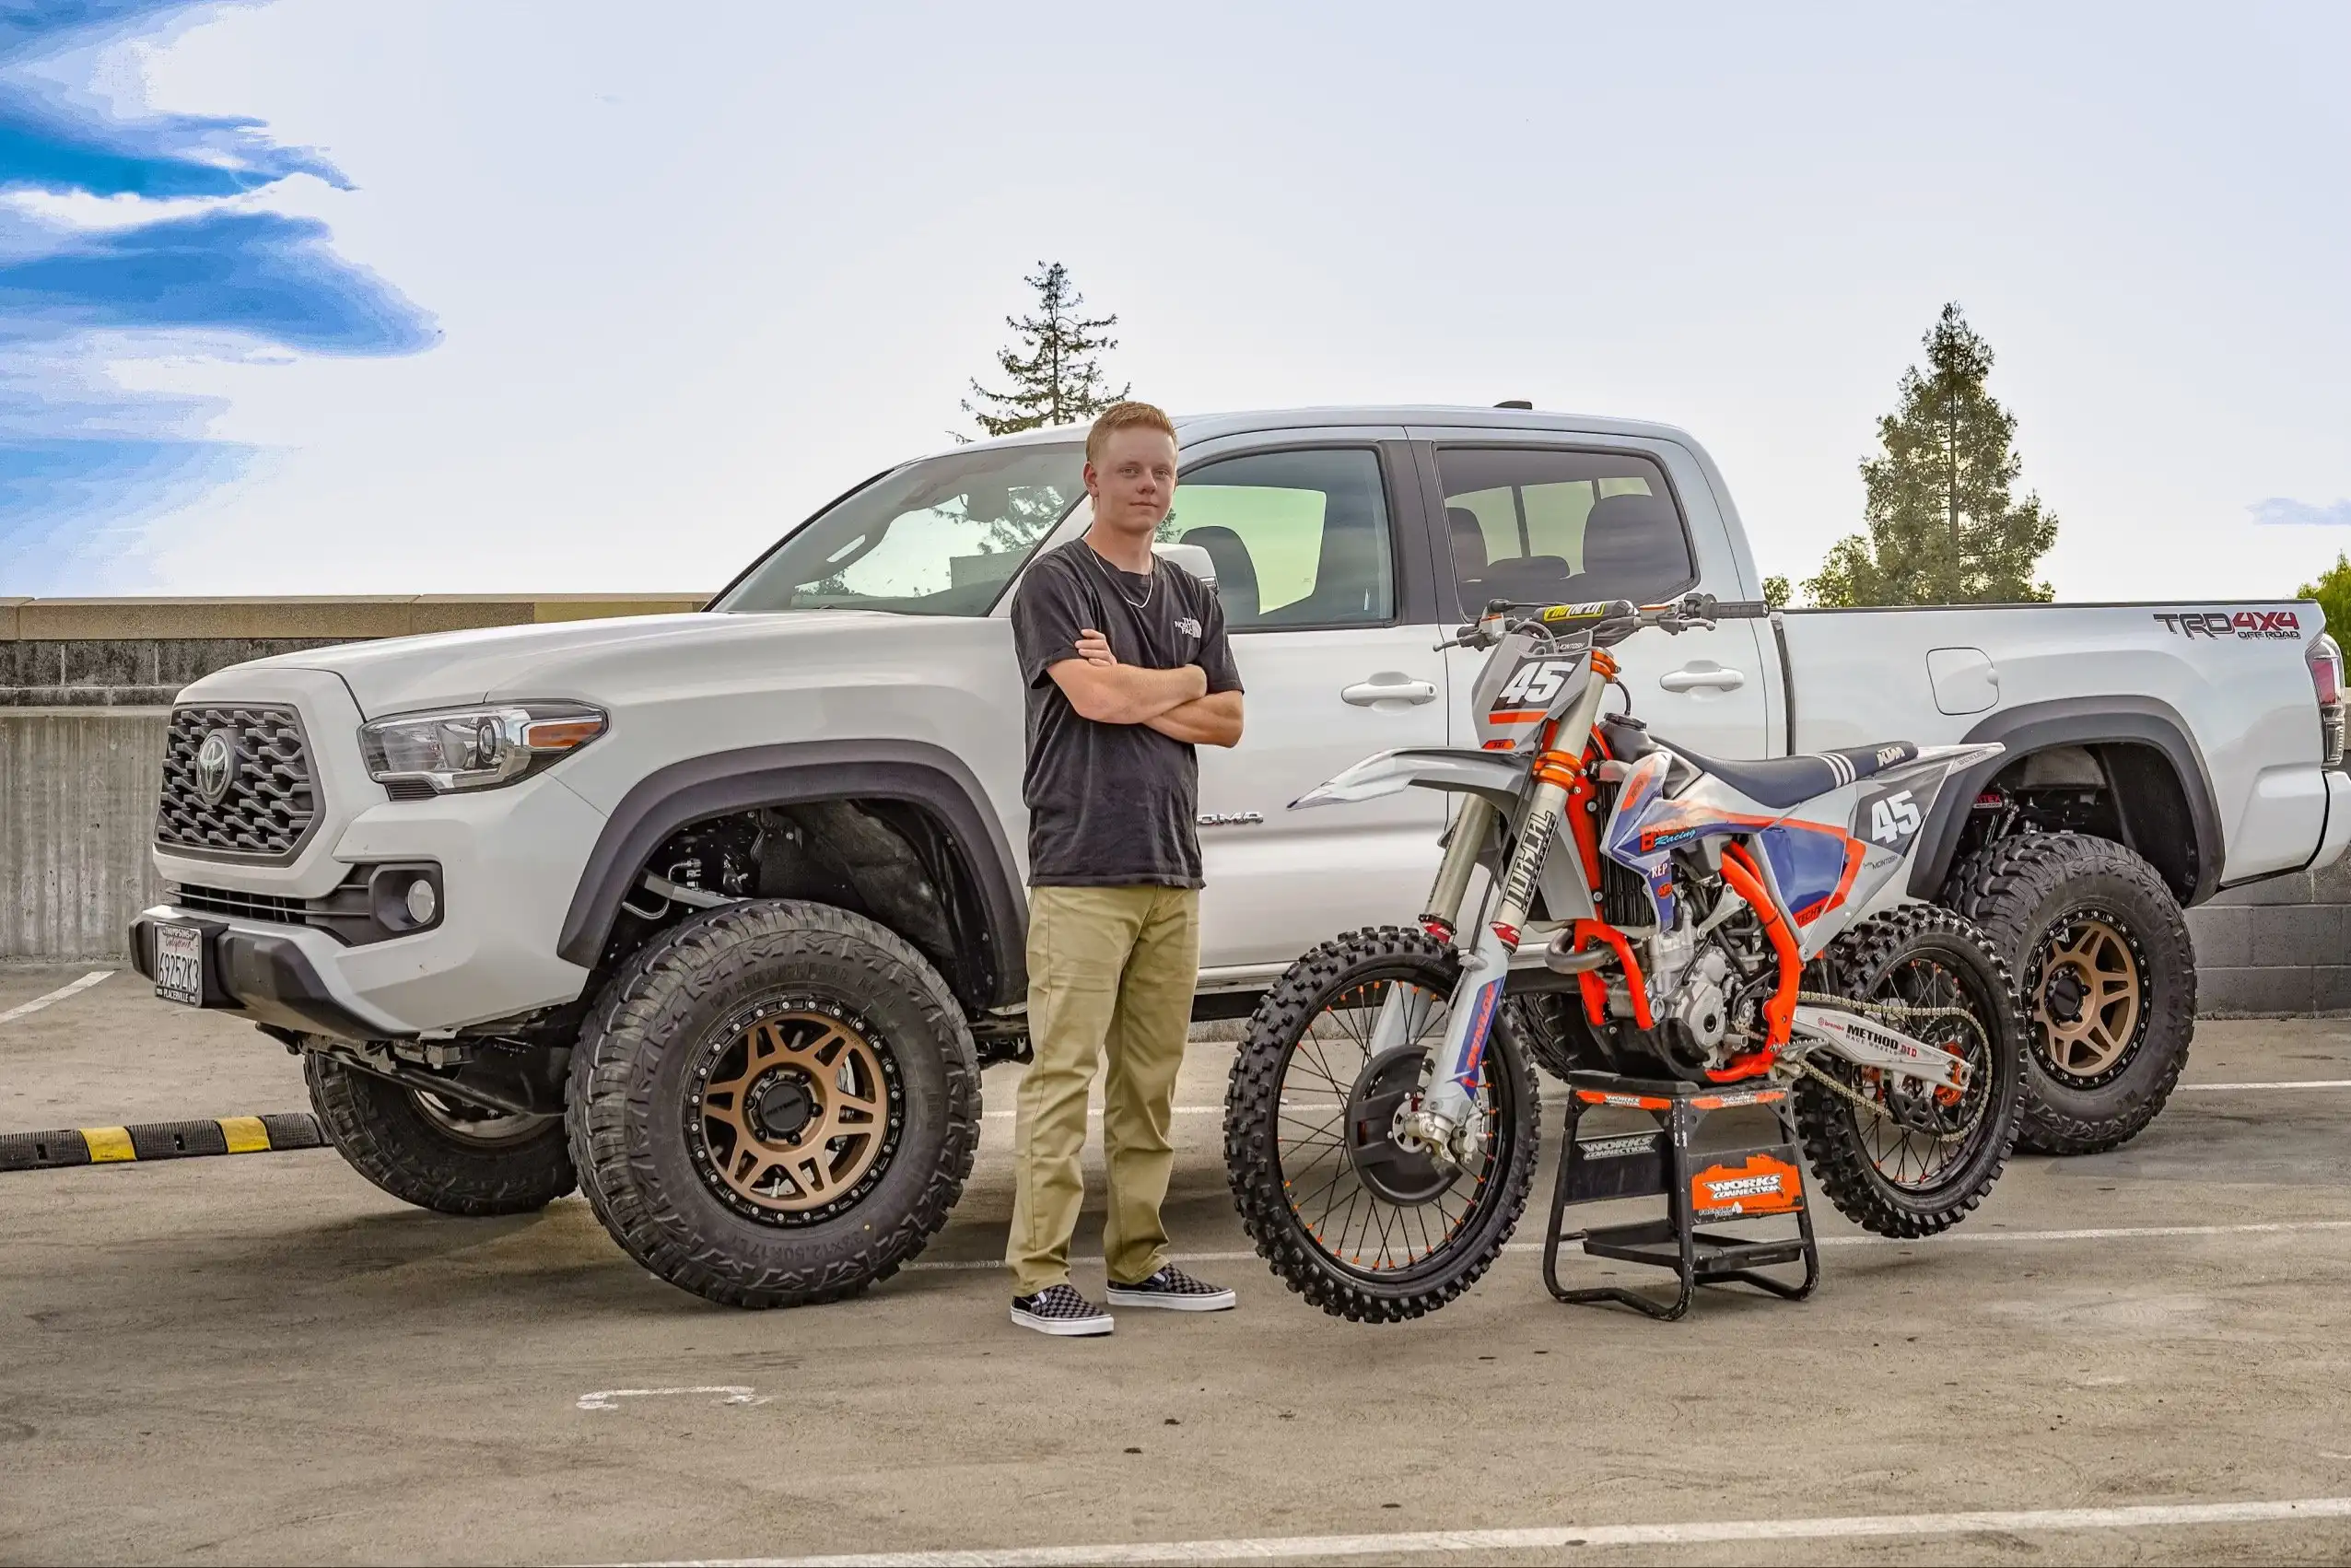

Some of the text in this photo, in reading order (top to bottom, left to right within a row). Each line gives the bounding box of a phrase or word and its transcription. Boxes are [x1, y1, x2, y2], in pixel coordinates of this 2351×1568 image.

[2153, 614, 2235, 639] TRD
[1498, 661, 1568, 704] 45
[1871, 790, 1922, 844] 45
[1655, 829, 1696, 847] Racing
[158, 953, 199, 992] 69252K3
[163, 989, 189, 1002] PLACERVILLE
[1846, 1034, 1865, 1045] RACE
[1846, 1024, 1917, 1058] METHOD DID
[1580, 1135, 1655, 1153] WORKS
[1706, 1175, 1782, 1192] WORKS
[1713, 1185, 1782, 1199] CONNECTION
